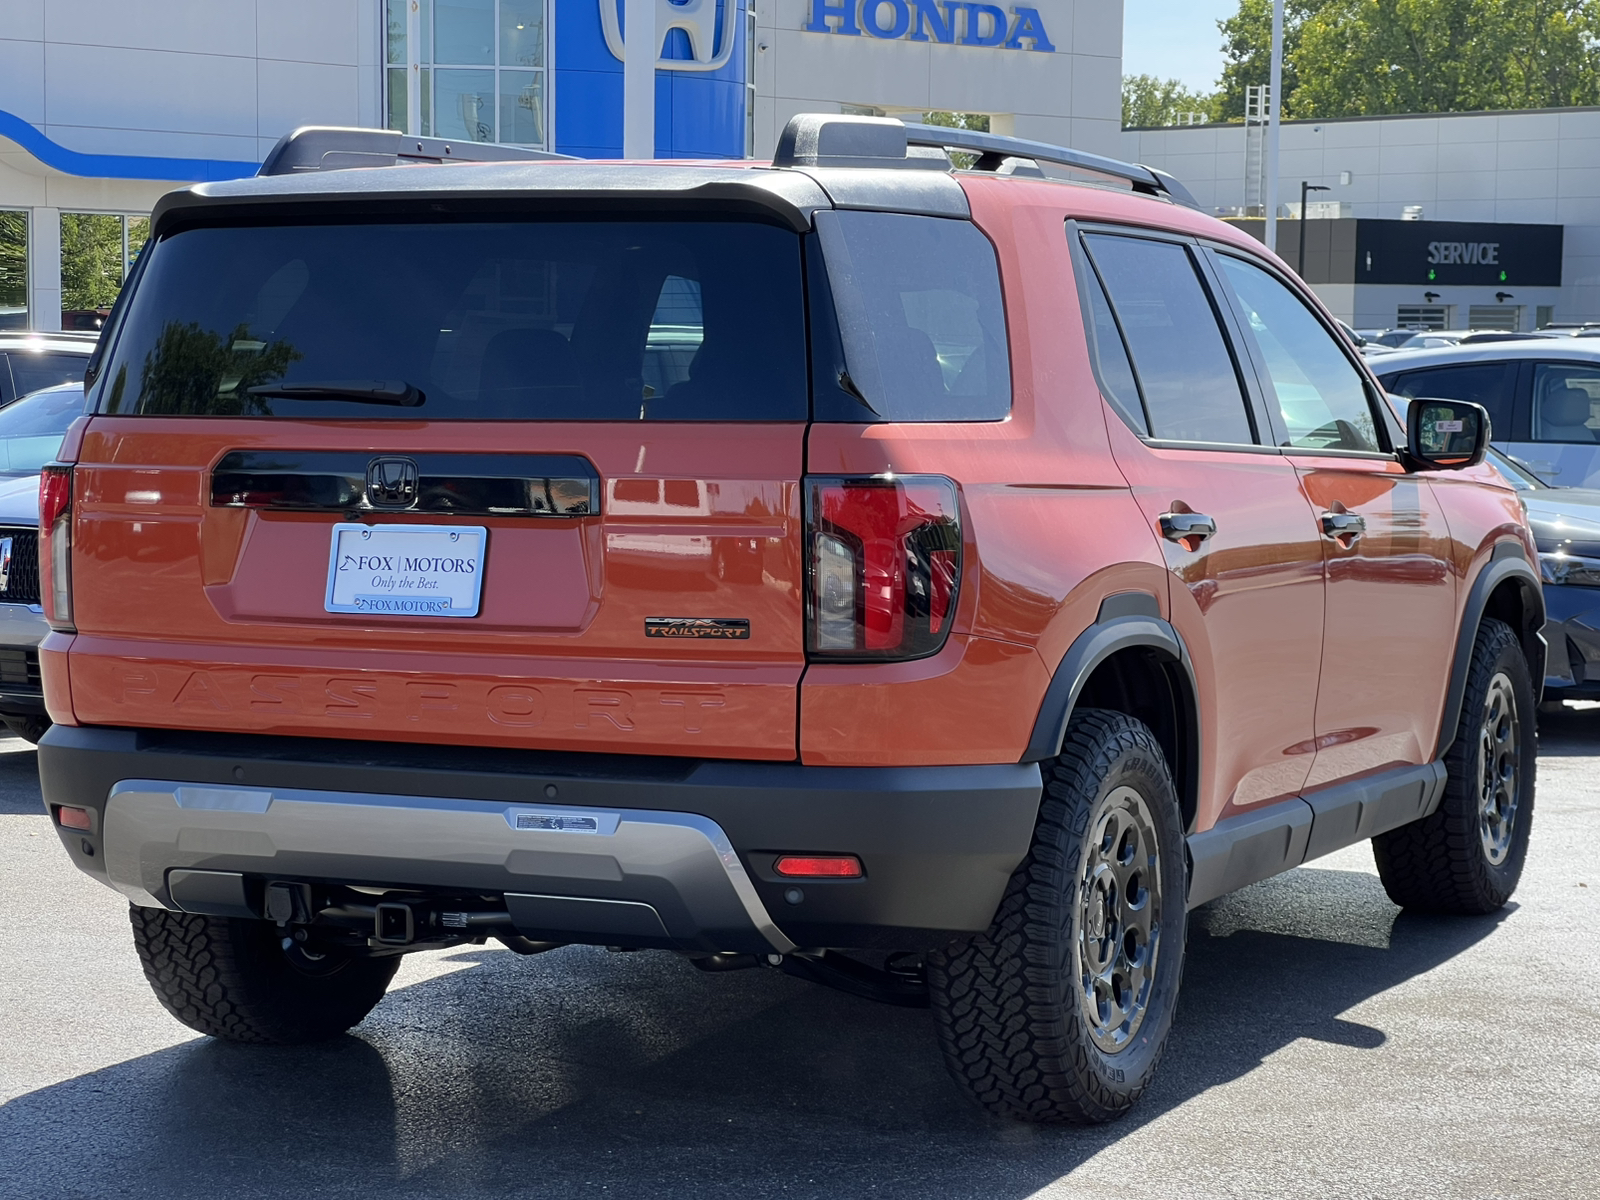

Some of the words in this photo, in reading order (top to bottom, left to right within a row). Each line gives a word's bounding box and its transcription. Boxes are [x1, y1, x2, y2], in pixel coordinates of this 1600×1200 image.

[802, 0, 1056, 53] HONDA
[1427, 241, 1499, 265] SERVICE
[358, 556, 394, 571] FOX
[403, 557, 476, 574] MOTORS
[371, 575, 397, 591] Only
[398, 577, 415, 589] the
[417, 577, 439, 590] Best.
[369, 600, 392, 611] FOX
[395, 601, 443, 613] MOTORS
[647, 626, 746, 638] TRAILSPORT
[111, 666, 726, 734] PASSPORT
